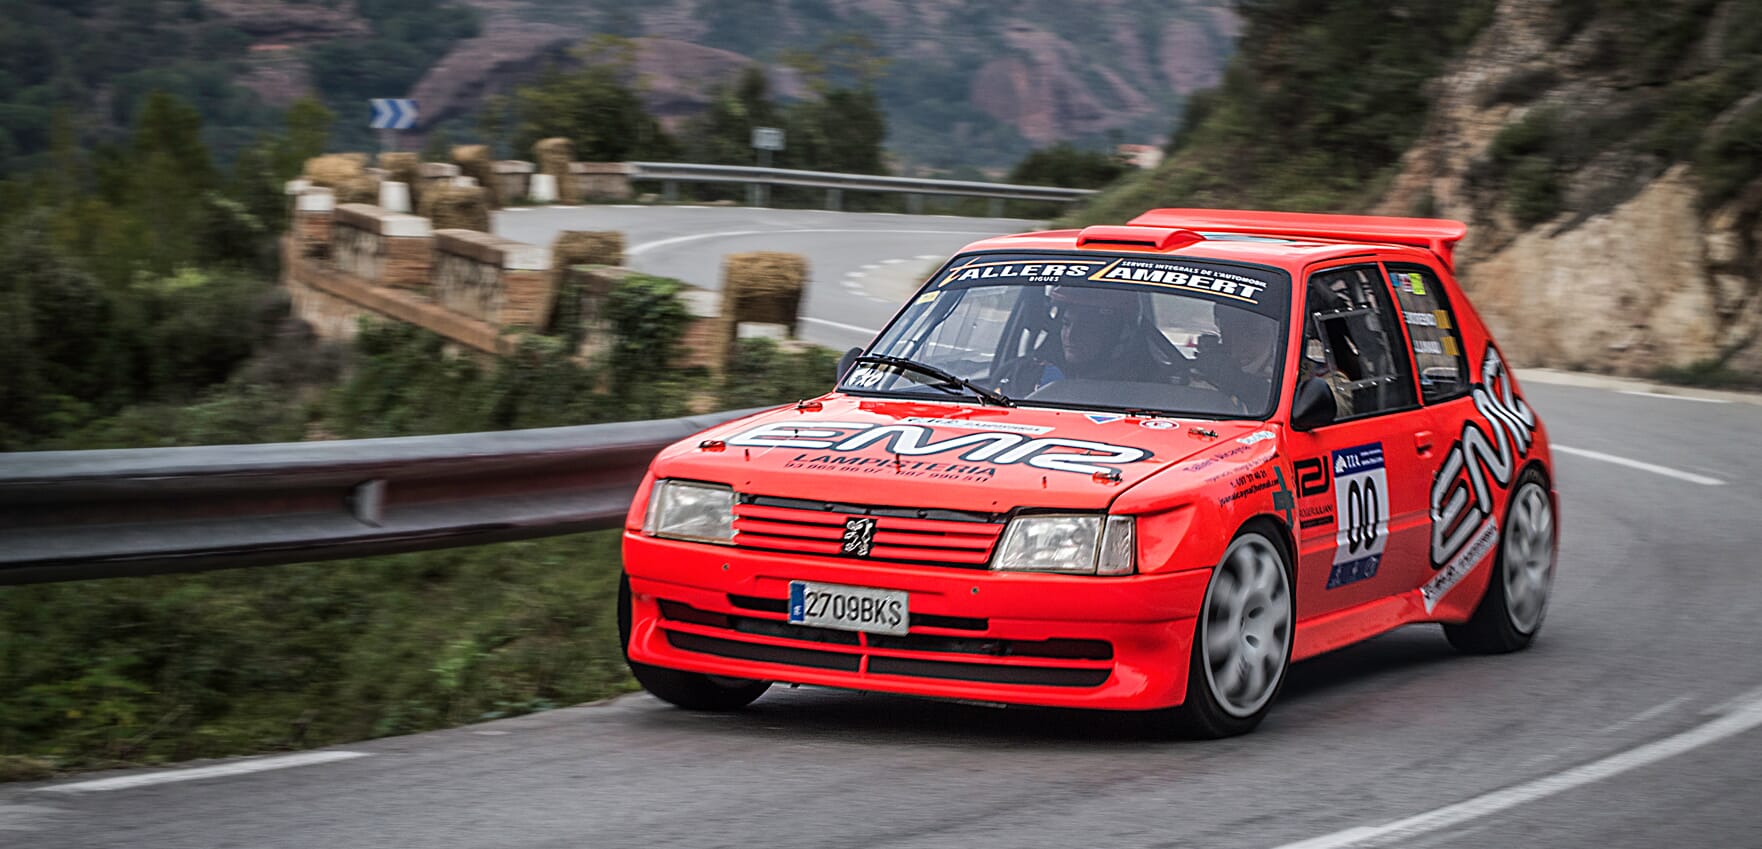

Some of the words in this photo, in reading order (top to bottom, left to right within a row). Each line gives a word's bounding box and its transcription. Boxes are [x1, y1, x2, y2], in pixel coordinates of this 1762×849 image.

[1121, 260, 1154, 269] SERVEIS
[1154, 263, 1199, 274] INTEGRALS
[792, 454, 996, 478] LAMPISTERIA
[1348, 475, 1380, 555] 00
